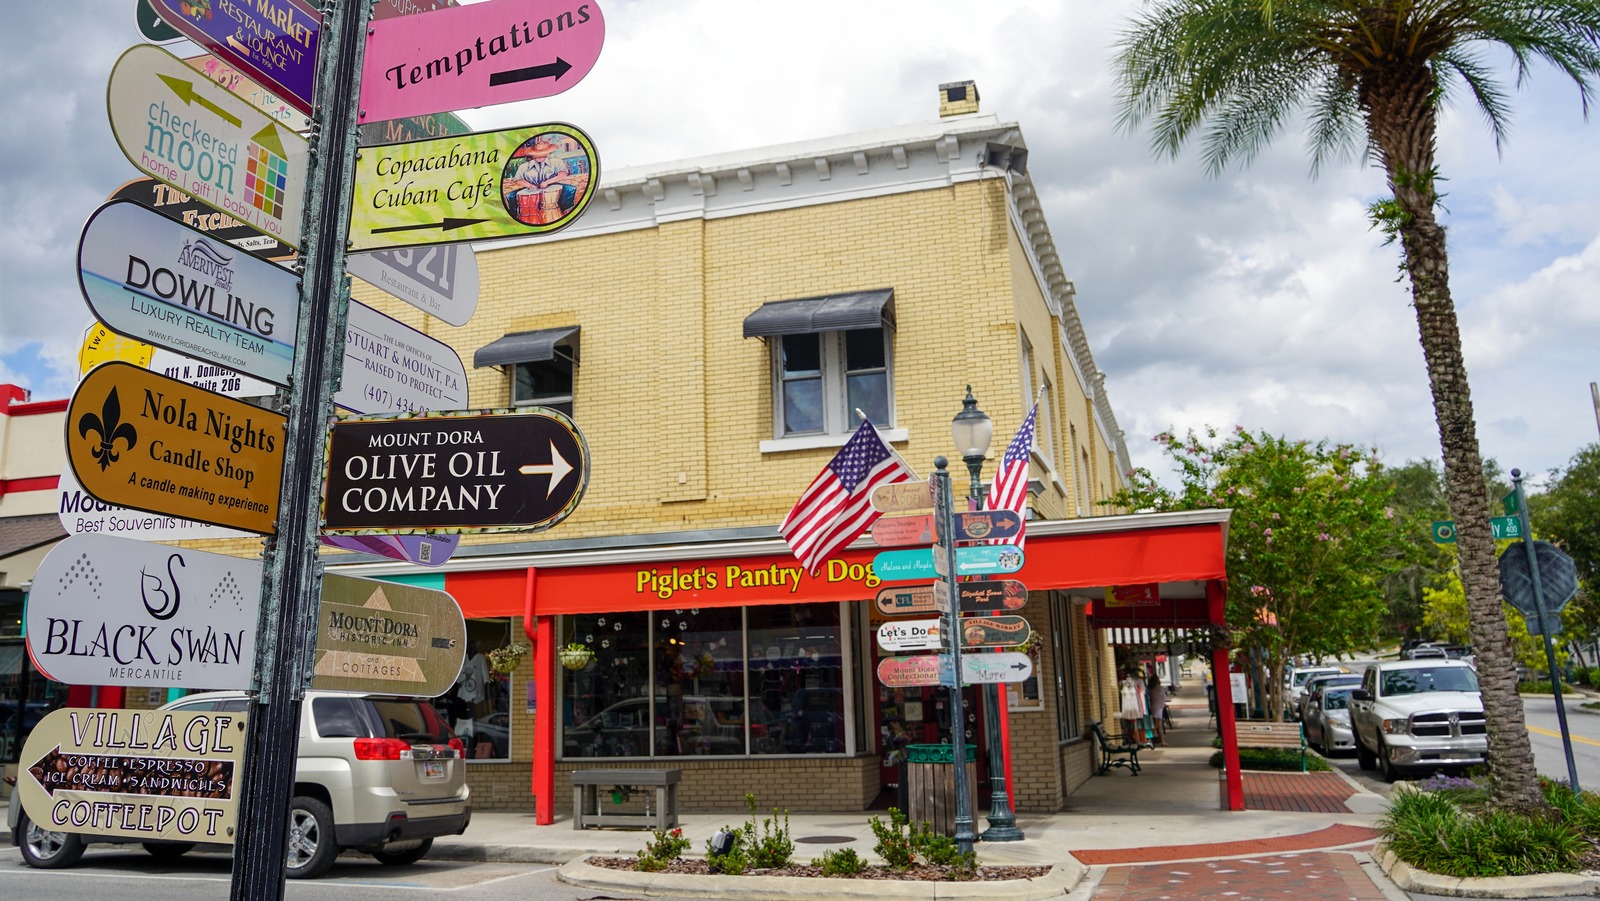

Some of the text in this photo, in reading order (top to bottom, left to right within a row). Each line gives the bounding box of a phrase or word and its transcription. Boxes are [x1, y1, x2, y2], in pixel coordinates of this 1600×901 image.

[219, 0, 304, 65] RESTAURANT
[256, 0, 313, 49] MARKET
[235, 26, 287, 72] & LOUNGE
[385, 4, 590, 90] Temptations
[148, 101, 238, 165] checkered
[144, 120, 234, 195] moon
[376, 143, 499, 185] Copacabana
[141, 151, 178, 181] home
[191, 180, 211, 198] gift
[223, 194, 253, 220] baby
[263, 218, 282, 235] you
[372, 172, 494, 211] Cuban Café
[177, 249, 234, 285] AMERIVEST
[125, 254, 275, 336] DOWLING
[381, 270, 420, 299] Restaurant
[429, 296, 441, 311] Bar
[131, 296, 264, 356] LUXURY REALTY TEAM
[346, 330, 460, 391] STUART & MOUNT, P.A.
[394, 339, 406, 349] LAW
[405, 344, 426, 360] OFFICES
[182, 366, 192, 379] N.
[221, 378, 241, 392] 206
[364, 358, 444, 400] RAISED TO PROTECT
[363, 383, 393, 409] (407)
[141, 388, 276, 454] Nola Nights
[368, 430, 484, 449] MOUNT DORA
[150, 440, 255, 490] Candle Shop
[344, 450, 506, 482] OLIVE OIL
[128, 471, 269, 514] A candle making experience
[342, 483, 506, 514] COMPANY
[76, 516, 105, 533] Best
[109, 516, 176, 532] Souvenirs
[636, 566, 717, 600] Piglet's
[726, 563, 804, 594] Pantry
[896, 596, 912, 605] CFL
[42, 617, 246, 668] BLACK SWAN
[329, 611, 419, 638] MOUNT DORA
[340, 633, 409, 647] HISTORIC INN
[880, 626, 926, 637] Let's Do
[109, 667, 183, 681] MERCANTILE
[342, 662, 401, 677] COTTAGES
[70, 712, 234, 755] VILLAGE
[46, 771, 226, 792] ICE CREAM SANDWICHES
[68, 755, 205, 775] COFFEE ESPRESSO
[52, 799, 223, 836] COFFEEPOT
